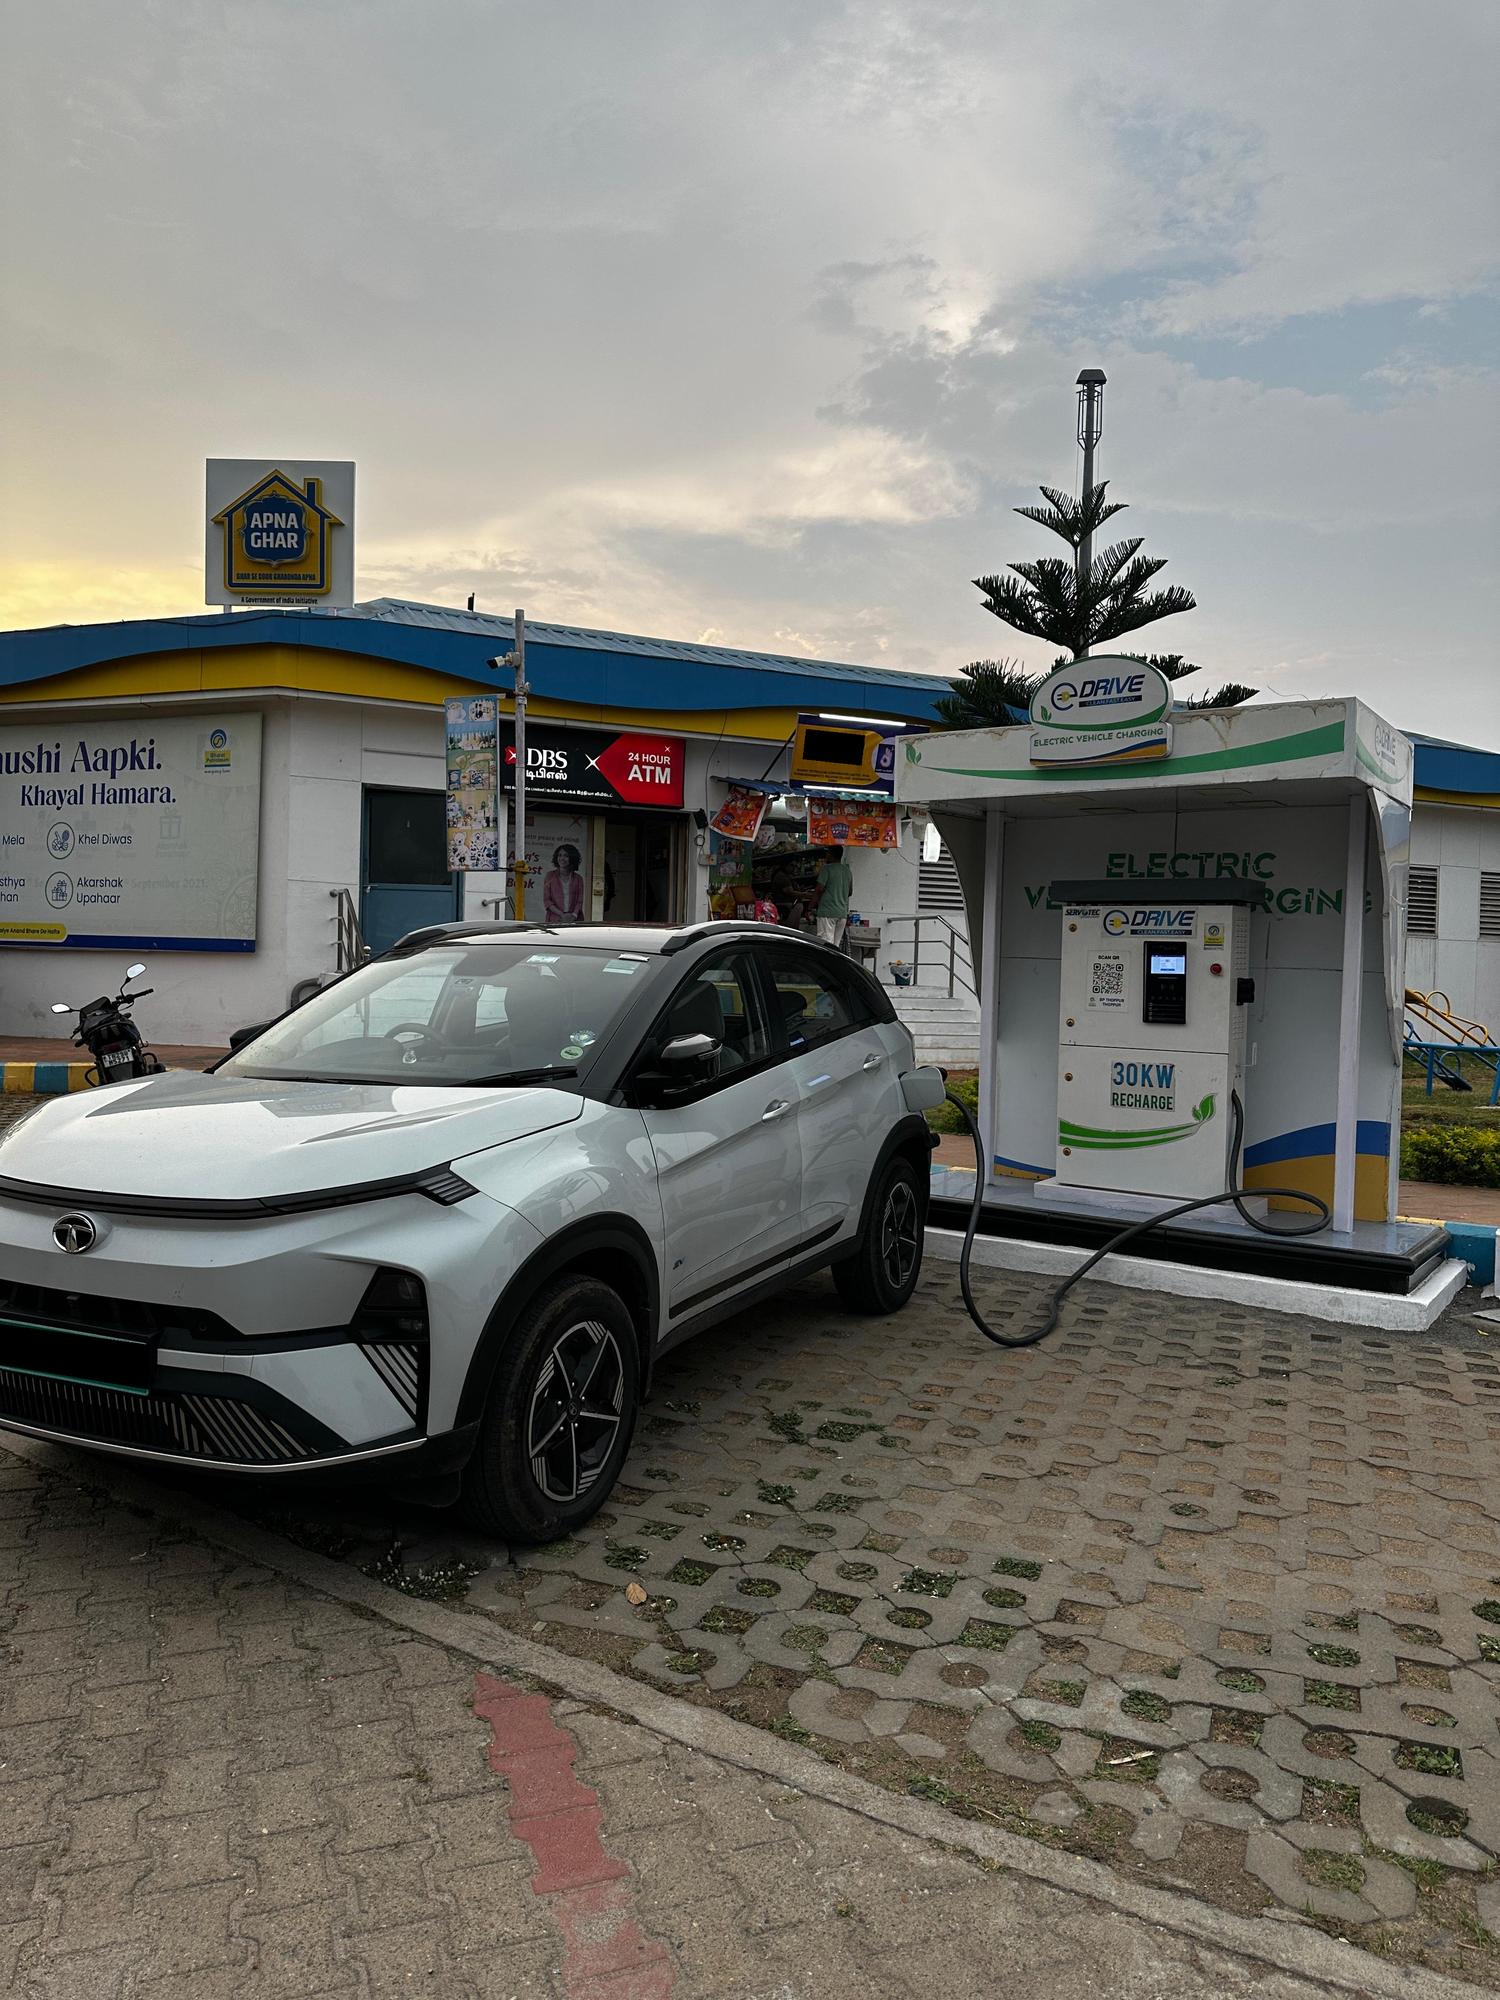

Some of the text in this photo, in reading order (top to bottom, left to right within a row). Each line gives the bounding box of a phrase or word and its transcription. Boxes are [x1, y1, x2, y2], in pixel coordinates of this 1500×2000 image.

[251, 513, 298, 529] APNA
[251, 533, 298, 548] GHAR
[245, 596, 275, 604] Government
[275, 596, 281, 604] of
[1033, 728, 1164, 747] ELECTRIC VEHICLE CHARGING
[0, 738, 162, 780] ushi Aapki.
[526, 747, 568, 769] DBS
[628, 752, 671, 765] 24 HOUR
[526, 767, 568, 781] டிபிஎஸ்
[627, 764, 671, 785] ATM
[21, 782, 176, 811] Khayal Hamara.
[2, 834, 25, 845] Mela
[78, 833, 132, 845] Khel Diwas
[1105, 852, 1277, 879] ELECTRIC
[77, 876, 123, 888] Akarshak
[76, 892, 121, 906] Upahaar
[1111, 1092, 1174, 1111] RECHARGE
